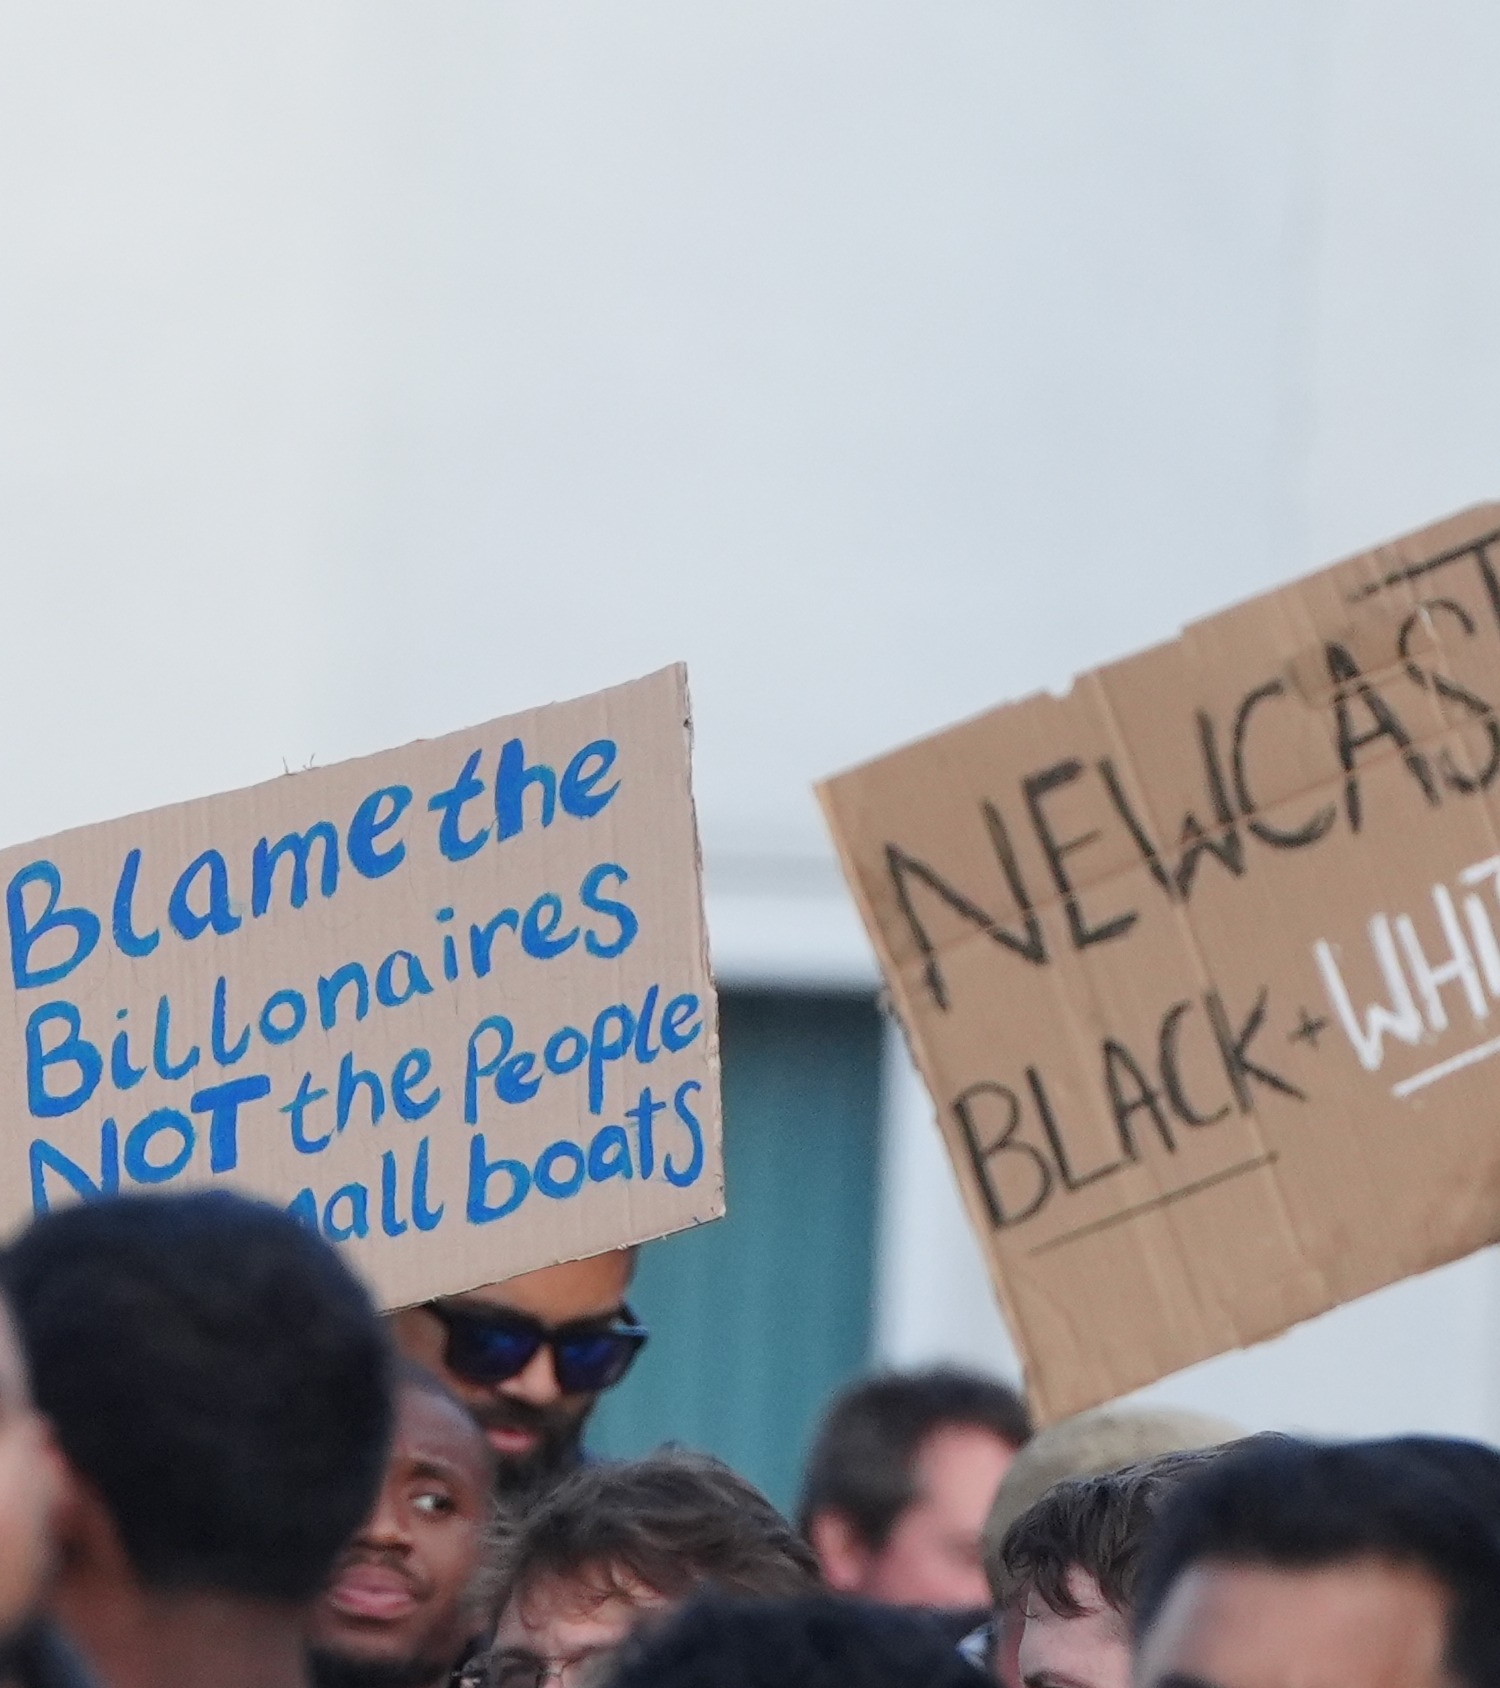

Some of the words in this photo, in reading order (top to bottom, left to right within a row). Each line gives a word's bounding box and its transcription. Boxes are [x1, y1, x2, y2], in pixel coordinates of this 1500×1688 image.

[4, 784, 413, 990] Blame
[427, 737, 623, 862] the
[24, 862, 640, 1119] Billonaires
[28, 1074, 271, 1218] NOT
[279, 1046, 441, 1156] the
[463, 984, 703, 1126] People
[952, 984, 1308, 1231] BLACK
[465, 1080, 705, 1227] boats
